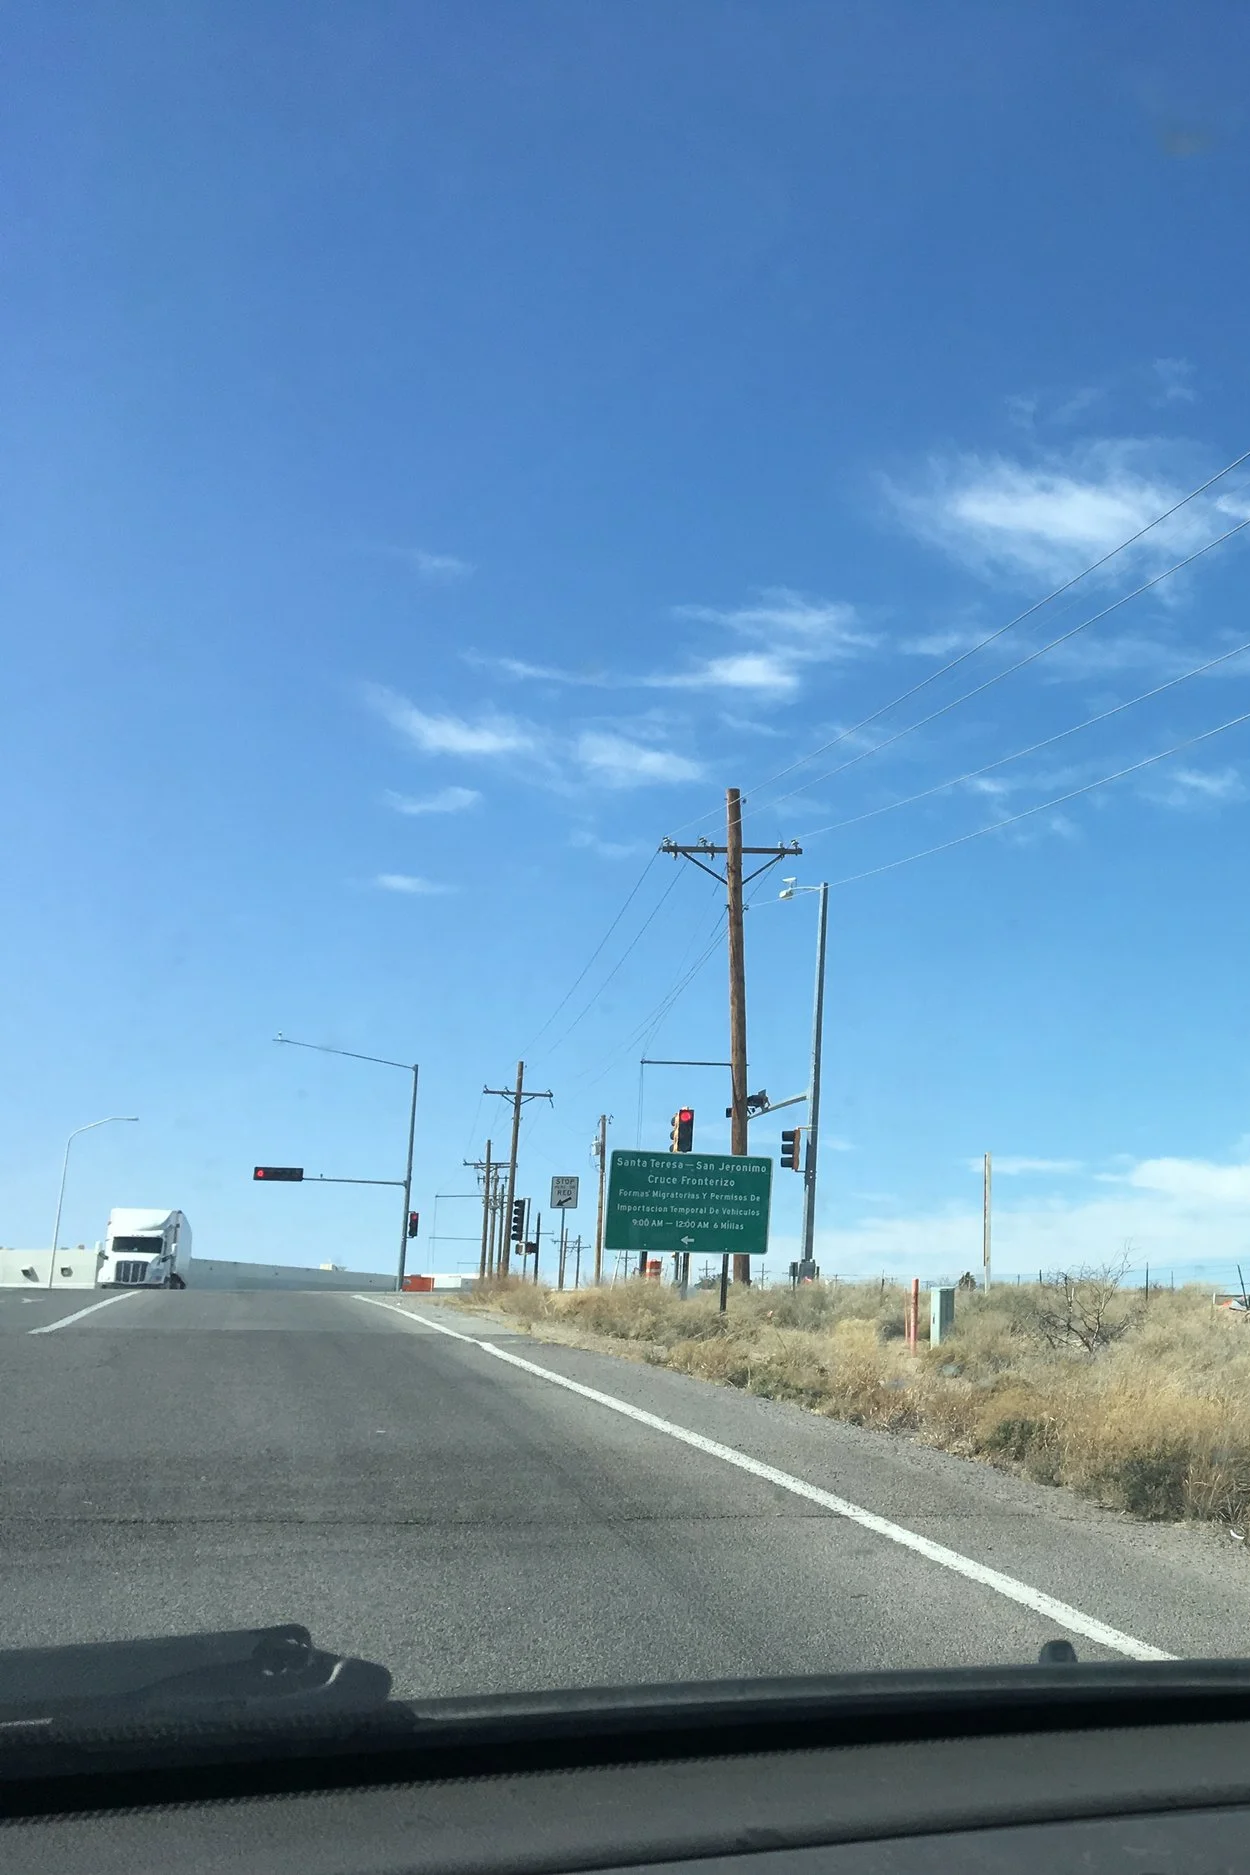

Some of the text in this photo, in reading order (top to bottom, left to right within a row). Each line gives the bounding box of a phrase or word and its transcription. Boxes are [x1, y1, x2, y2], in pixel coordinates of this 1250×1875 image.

[617, 1158, 647, 1168] Santa
[650, 1159, 683, 1169] Teresa
[696, 1161, 714, 1171] San
[719, 1163, 767, 1173] Jeronimo
[648, 1175, 735, 1187] Cruce Fronterizo
[619, 1189, 650, 1197] Formas
[652, 1190, 699, 1200] Migratorias
[710, 1193, 747, 1201] Permisos
[617, 1204, 668, 1212] Importacion
[670, 1206, 706, 1215] Temporal
[721, 1222, 744, 1230] Millas
